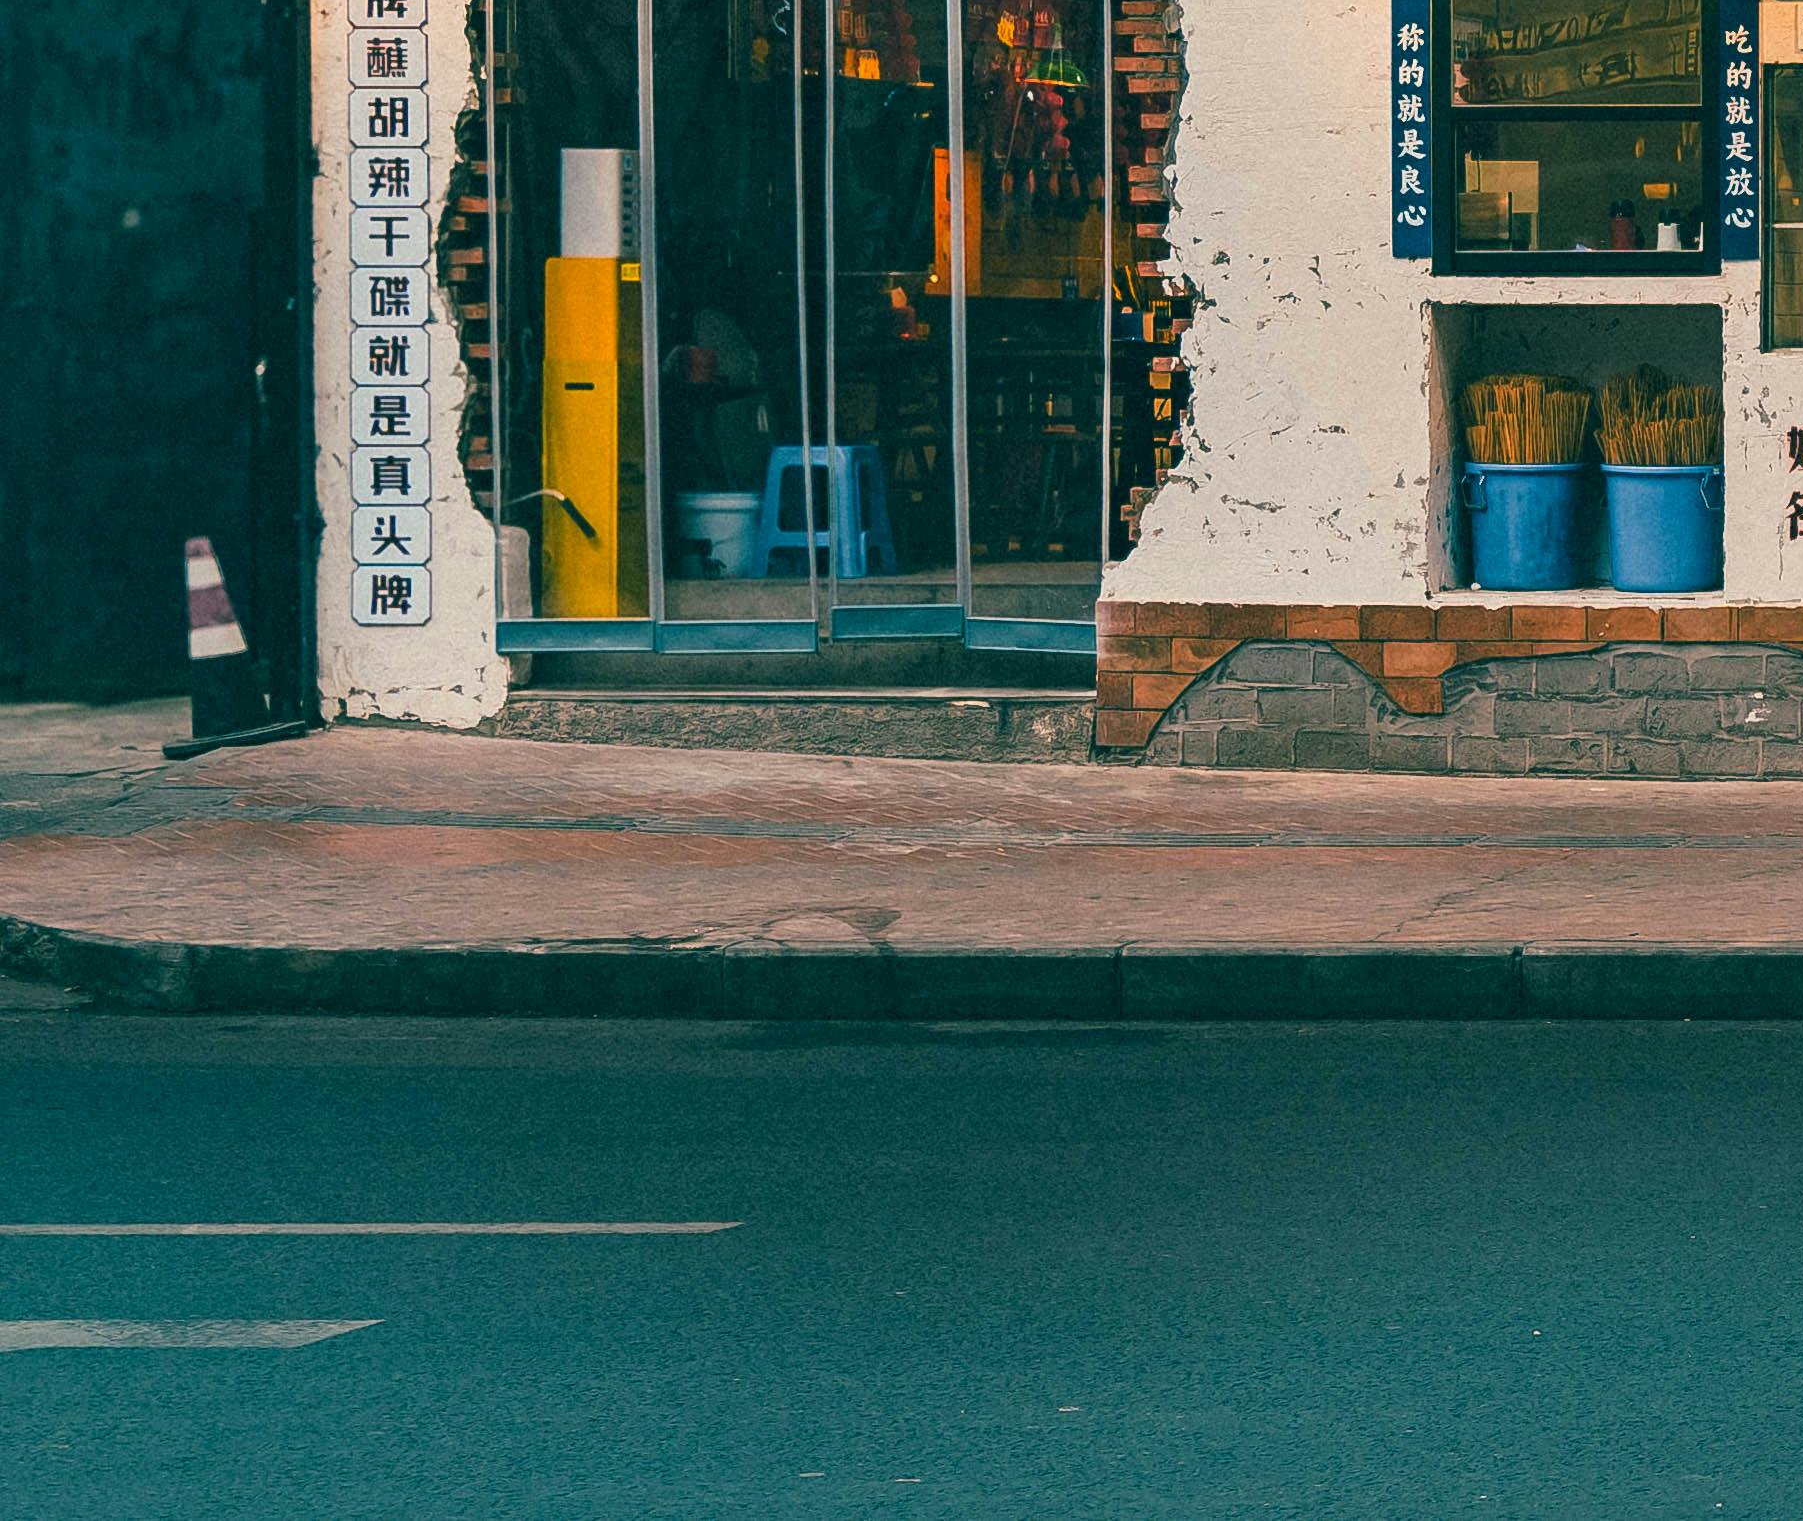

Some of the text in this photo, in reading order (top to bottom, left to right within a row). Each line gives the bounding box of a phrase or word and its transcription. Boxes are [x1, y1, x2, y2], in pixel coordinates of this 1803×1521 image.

[1396, 23, 1428, 228] 称的就是良心
[1724, 24, 1755, 230] 吃的就是放心
